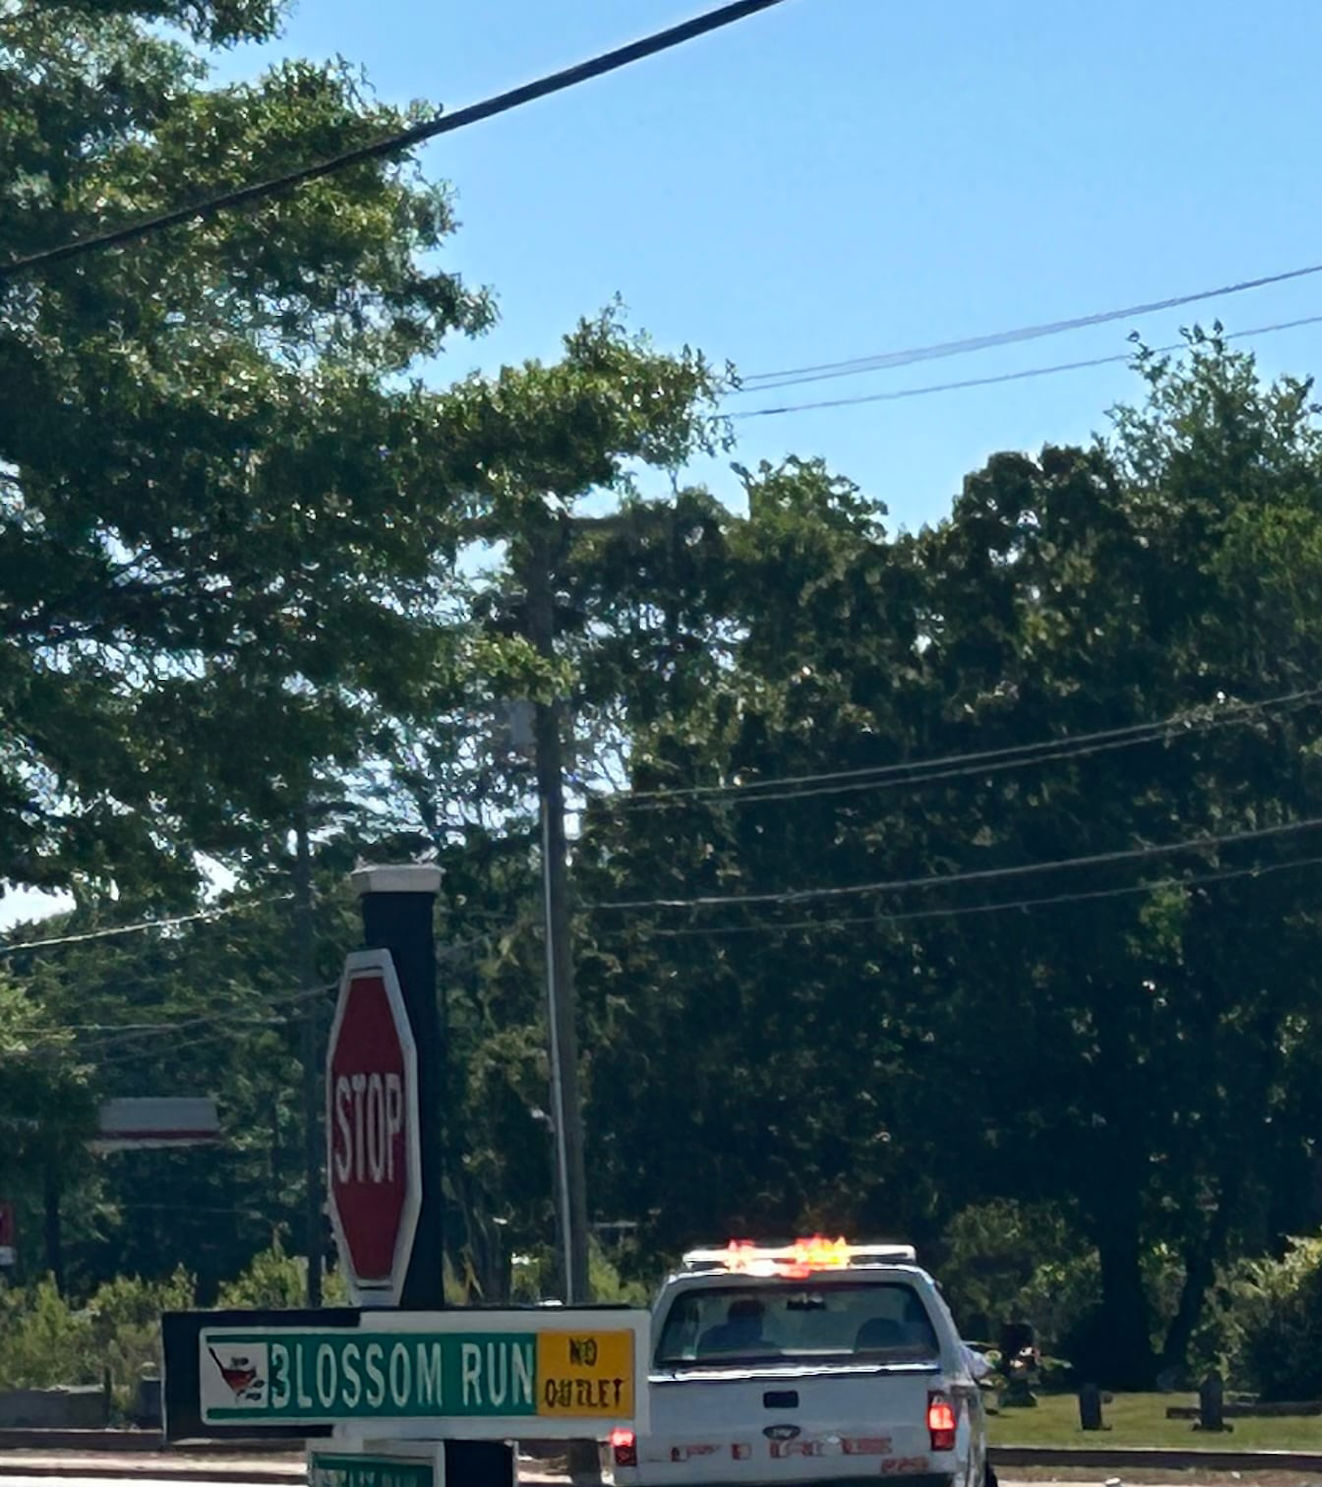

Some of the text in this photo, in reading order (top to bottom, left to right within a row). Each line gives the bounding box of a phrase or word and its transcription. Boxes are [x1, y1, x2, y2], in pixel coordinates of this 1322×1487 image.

[335, 1072, 402, 1183] STOP
[270, 1342, 534, 1410] BLOSSOM RUN
[569, 1337, 598, 1368] NO
[544, 1377, 628, 1410] OUTLET
